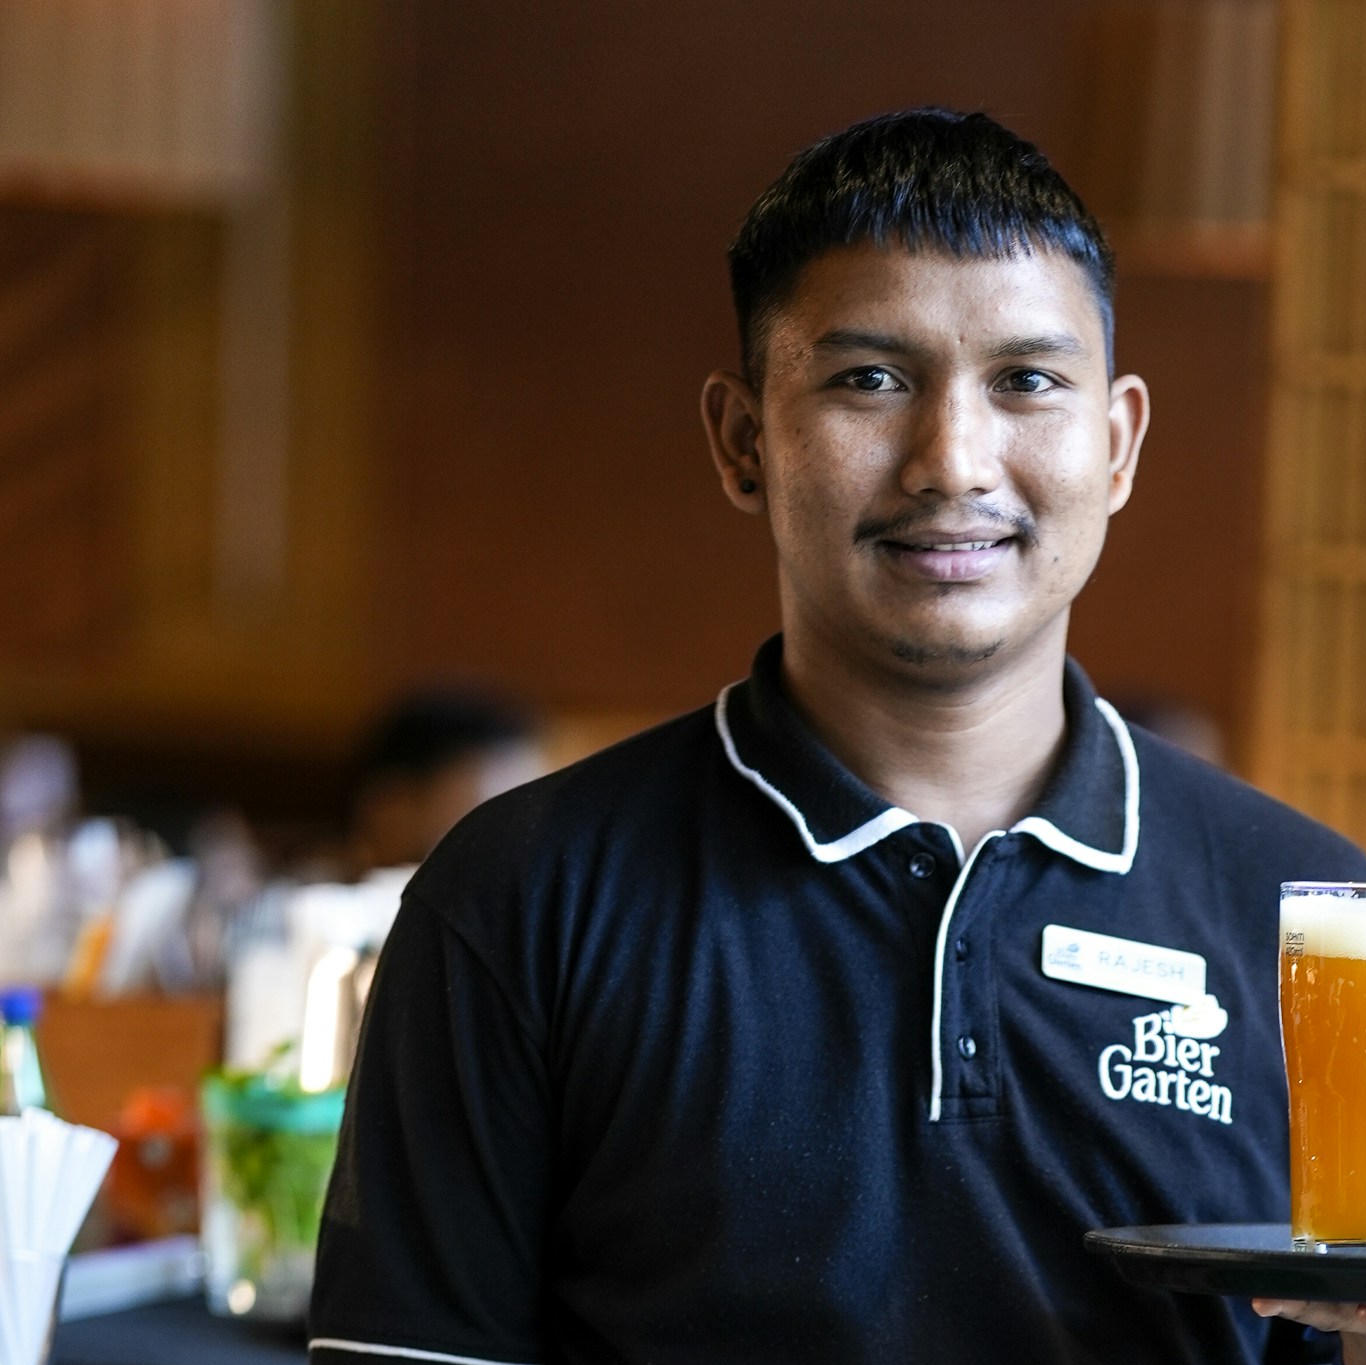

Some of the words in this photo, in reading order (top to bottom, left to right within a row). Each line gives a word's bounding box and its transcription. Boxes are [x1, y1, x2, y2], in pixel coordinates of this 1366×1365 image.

[1098, 951, 1185, 980] RAJESH
[1133, 1012, 1220, 1077] Bier
[1098, 1044, 1233, 1125] Garten
